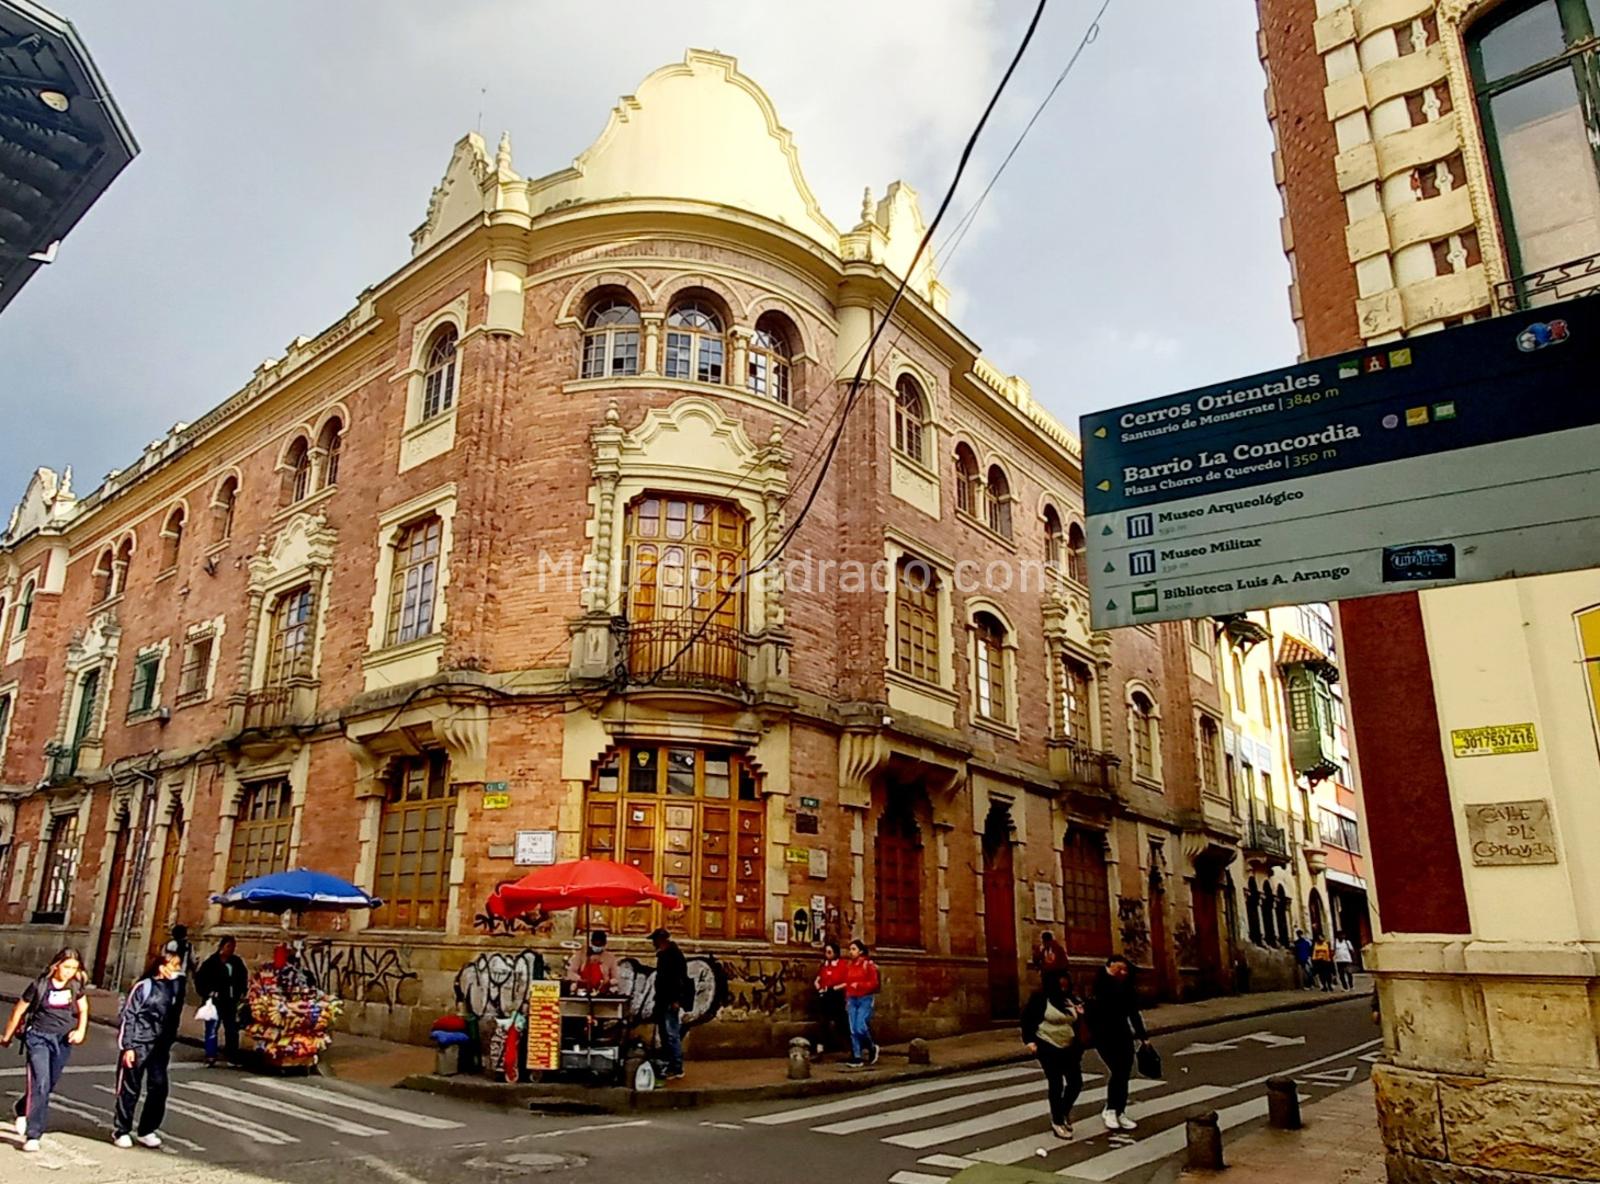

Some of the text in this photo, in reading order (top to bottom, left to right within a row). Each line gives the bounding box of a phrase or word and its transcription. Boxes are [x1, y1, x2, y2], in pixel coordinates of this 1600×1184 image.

[1120, 373, 1320, 429] Cerros Orientales
[1121, 388, 1339, 443] Santuario de Monserrate 3840 m
[1123, 423, 1360, 482] Barrio La Concordia
[1124, 449, 1337, 496] Plaza Chorro de Quevedo 350 m
[1159, 489, 1304, 523] Museo Arqueológico
[1161, 536, 1262, 561] Museo Militar
[1163, 566, 1350, 600] Biblioteca Luis A. Arango
[1463, 732, 1534, 749] 3017537416
